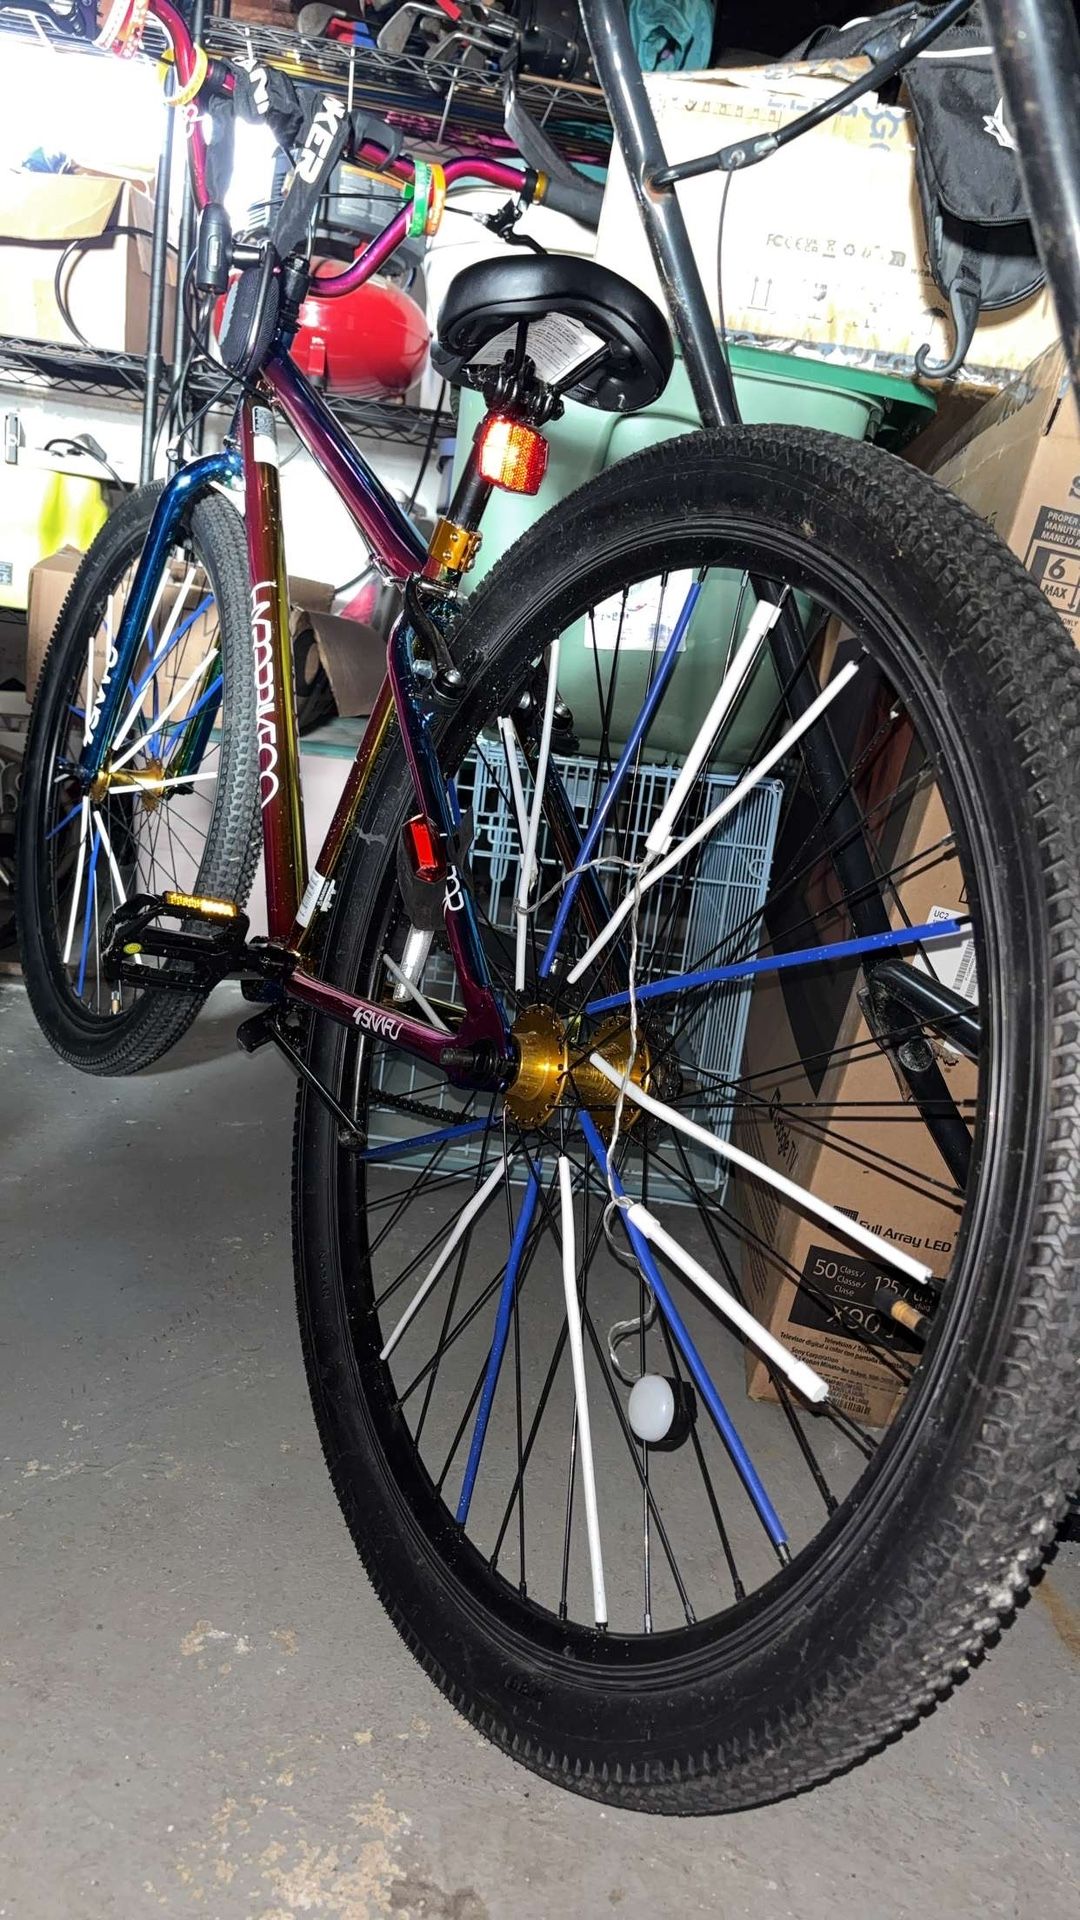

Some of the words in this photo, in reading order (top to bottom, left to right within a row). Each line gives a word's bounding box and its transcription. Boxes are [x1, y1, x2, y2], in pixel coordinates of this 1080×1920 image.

[1047, 511, 1078, 526] PROPER
[1041, 530, 1074, 545] MANEJO
[1048, 558, 1066, 580] 6
[1044, 583, 1069, 600] MAX
[933, 909, 950, 920] UC2
[883, 1227, 922, 1249] Array
[924, 1237, 952, 1253] LED
[812, 1259, 838, 1279] 50
